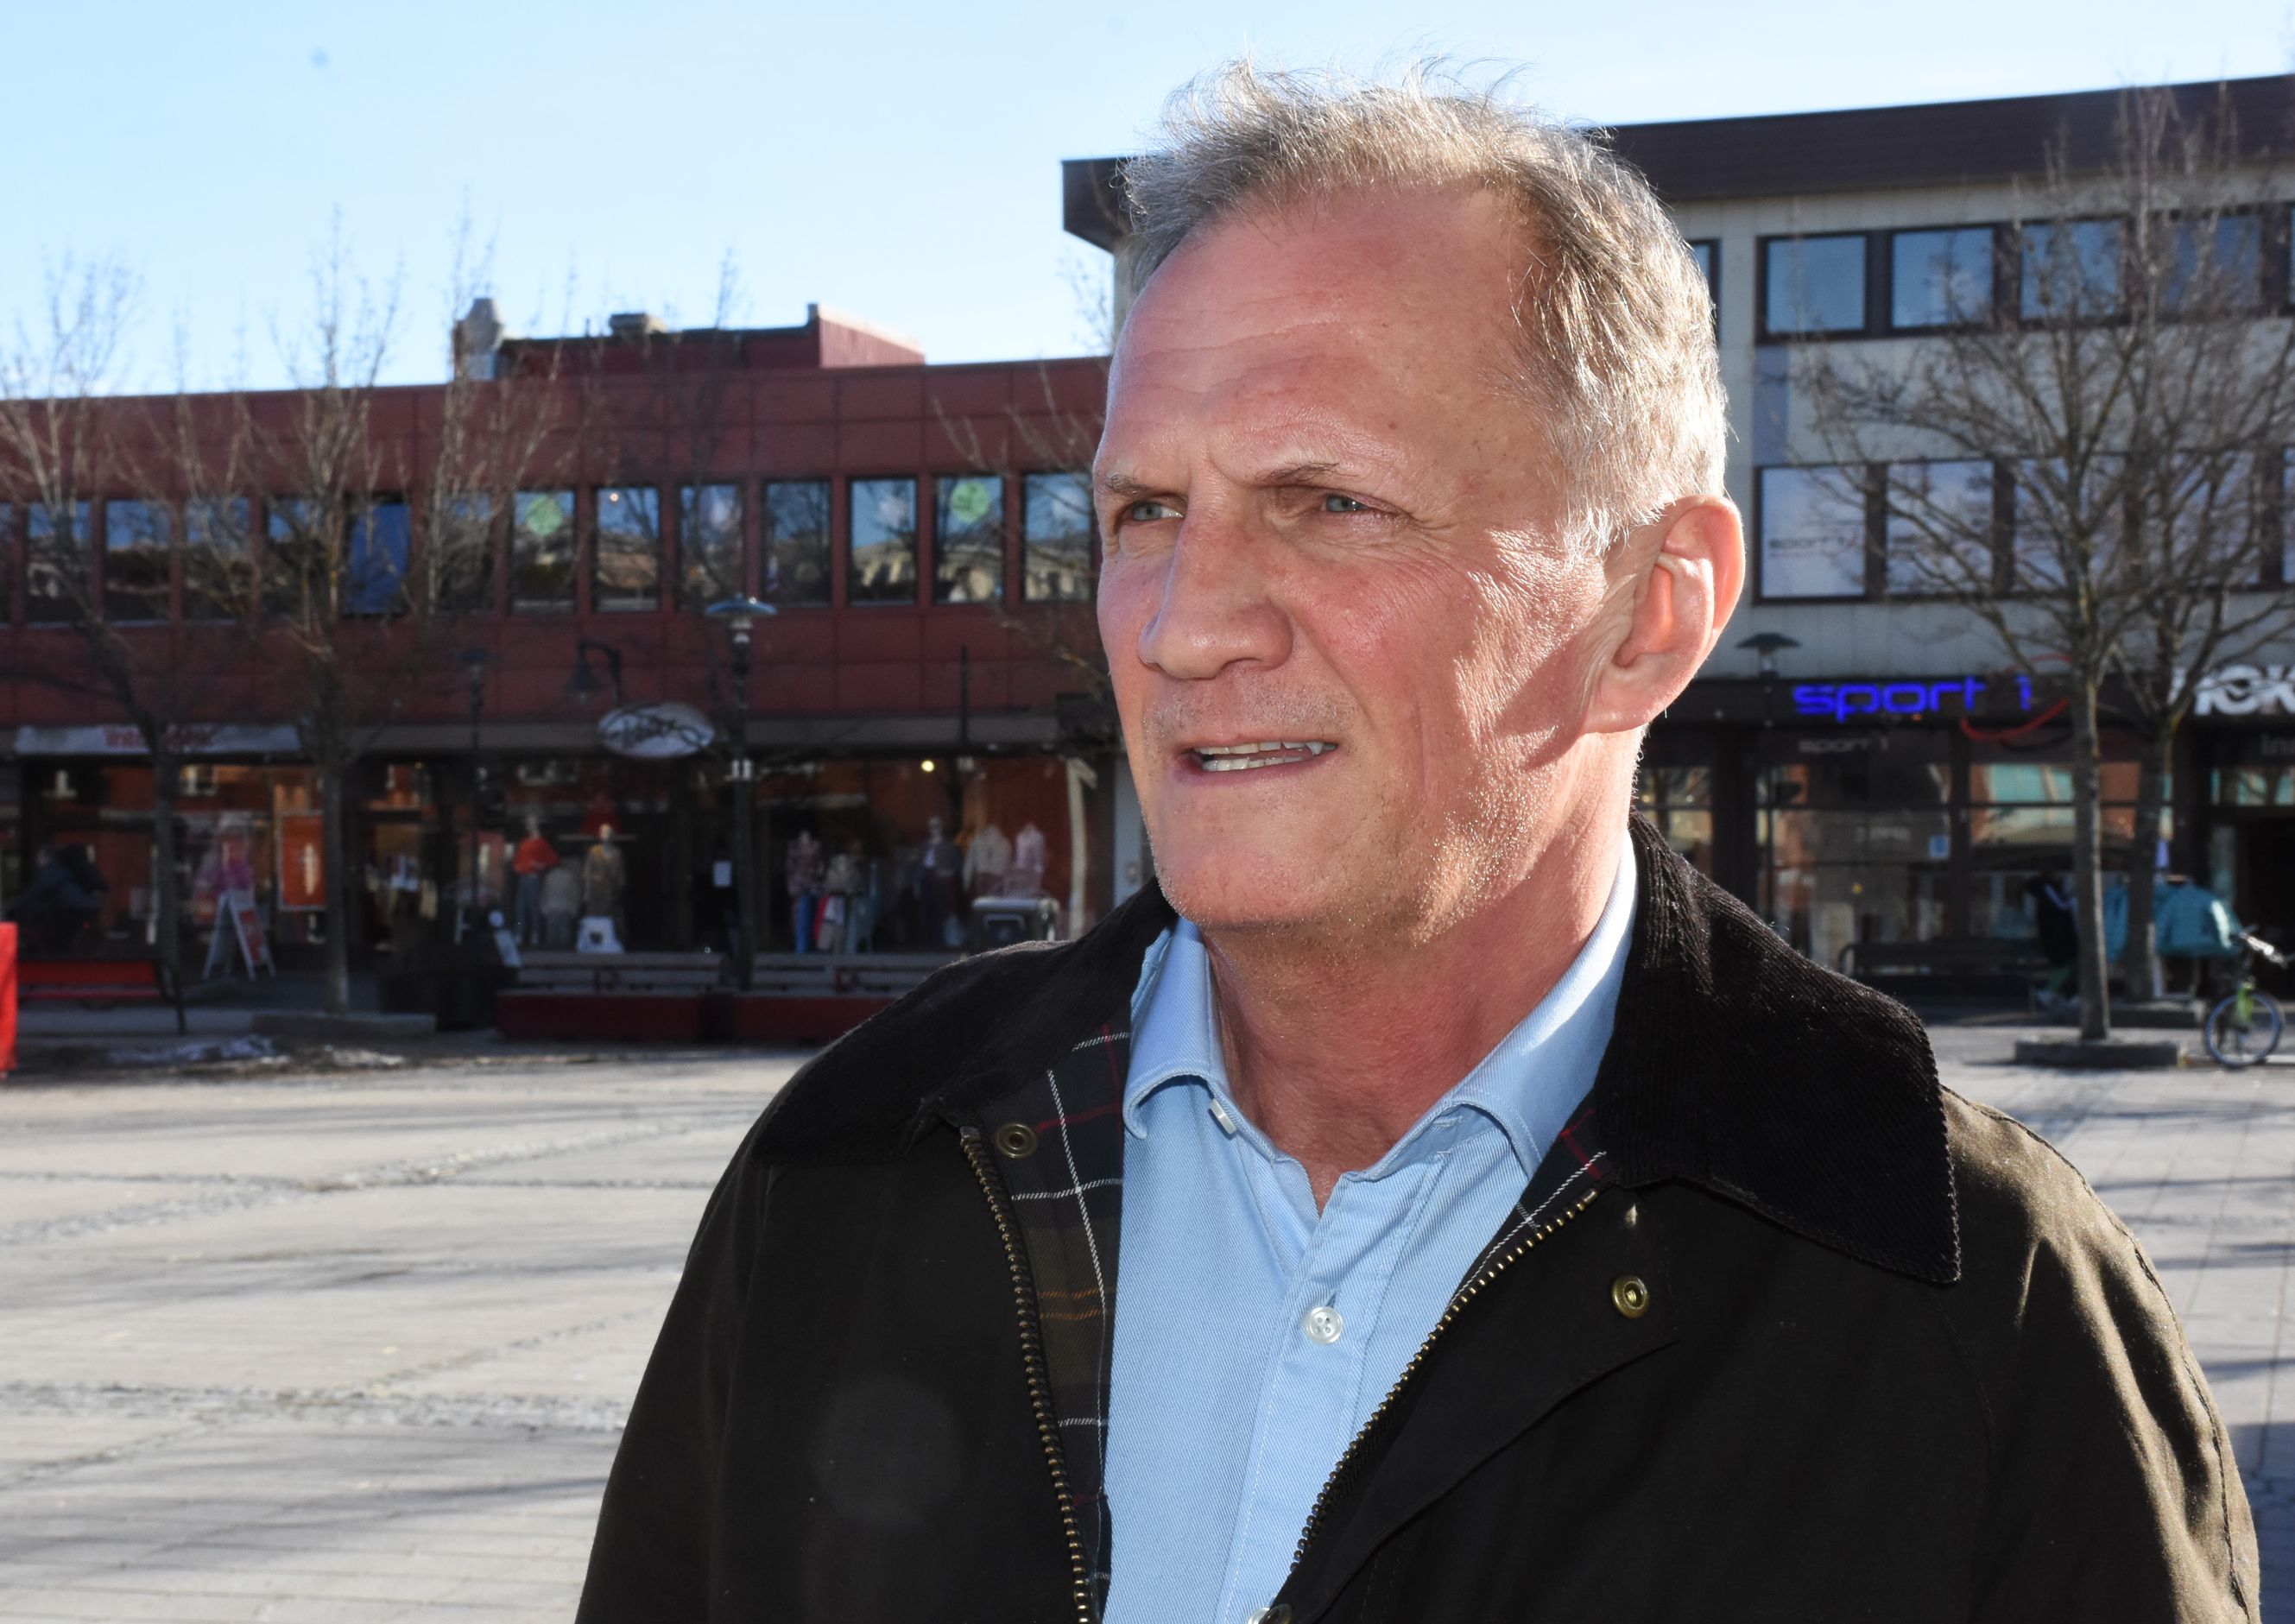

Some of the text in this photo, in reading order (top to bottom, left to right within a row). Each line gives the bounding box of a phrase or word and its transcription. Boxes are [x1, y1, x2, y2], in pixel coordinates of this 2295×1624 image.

[1793, 674, 2033, 722] sport 1
[1799, 736, 1872, 755] sport
